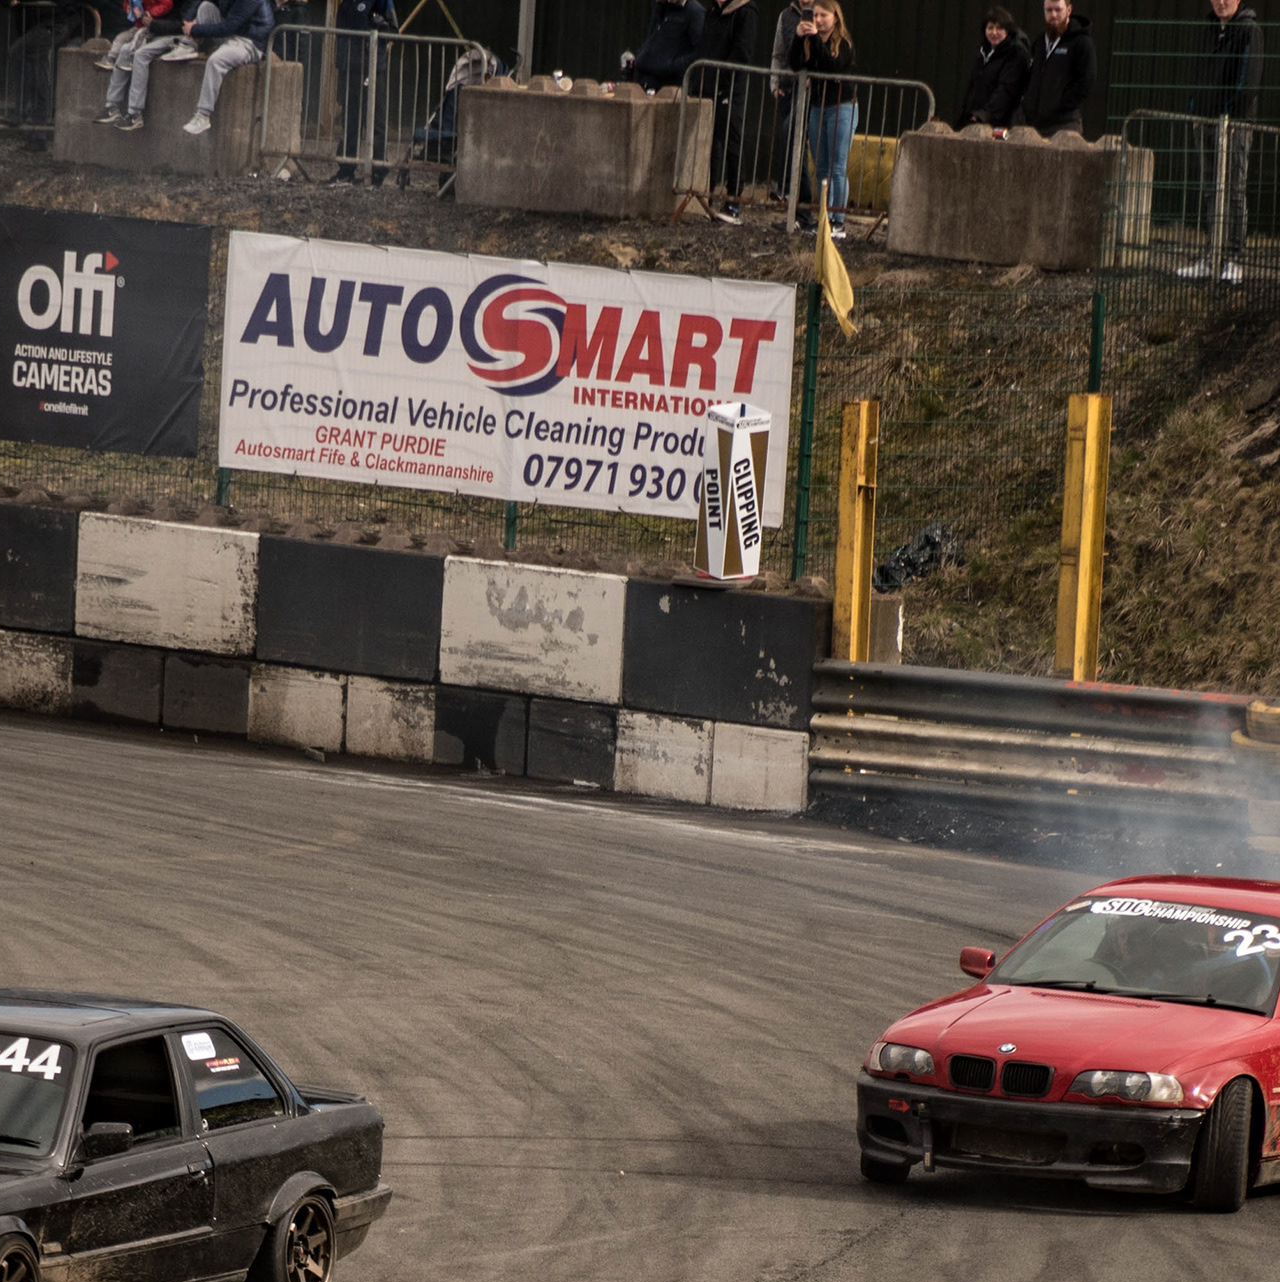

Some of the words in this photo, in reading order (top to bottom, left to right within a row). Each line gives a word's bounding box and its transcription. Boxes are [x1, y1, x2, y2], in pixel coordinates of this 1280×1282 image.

[14, 343, 48, 360] ACTION
[48, 347, 68, 362] AND
[68, 350, 113, 366] LIFESTYLE
[12, 360, 113, 397] CAMERAS
[39, 401, 89, 416] #onelifefilmit
[228, 379, 401, 426] Professional
[407, 398, 496, 437] Vehicle
[504, 408, 625, 455] Cleaning
[572, 386, 732, 418] INTERNATIO
[315, 425, 377, 450] GRANT
[379, 432, 447, 457] PURDIE
[235, 438, 315, 464] Autosmart
[319, 447, 346, 467] Fife
[351, 452, 361, 468] &
[365, 452, 494, 484] Clackmannanshire
[523, 453, 618, 494] 07971
[628, 464, 686, 501] 930
[706, 468, 722, 531] POINT
[733, 457, 759, 550] CLIPPING
[1103, 898, 1152, 915] SDC
[1144, 908, 1251, 929] CHAMPIONSHIP
